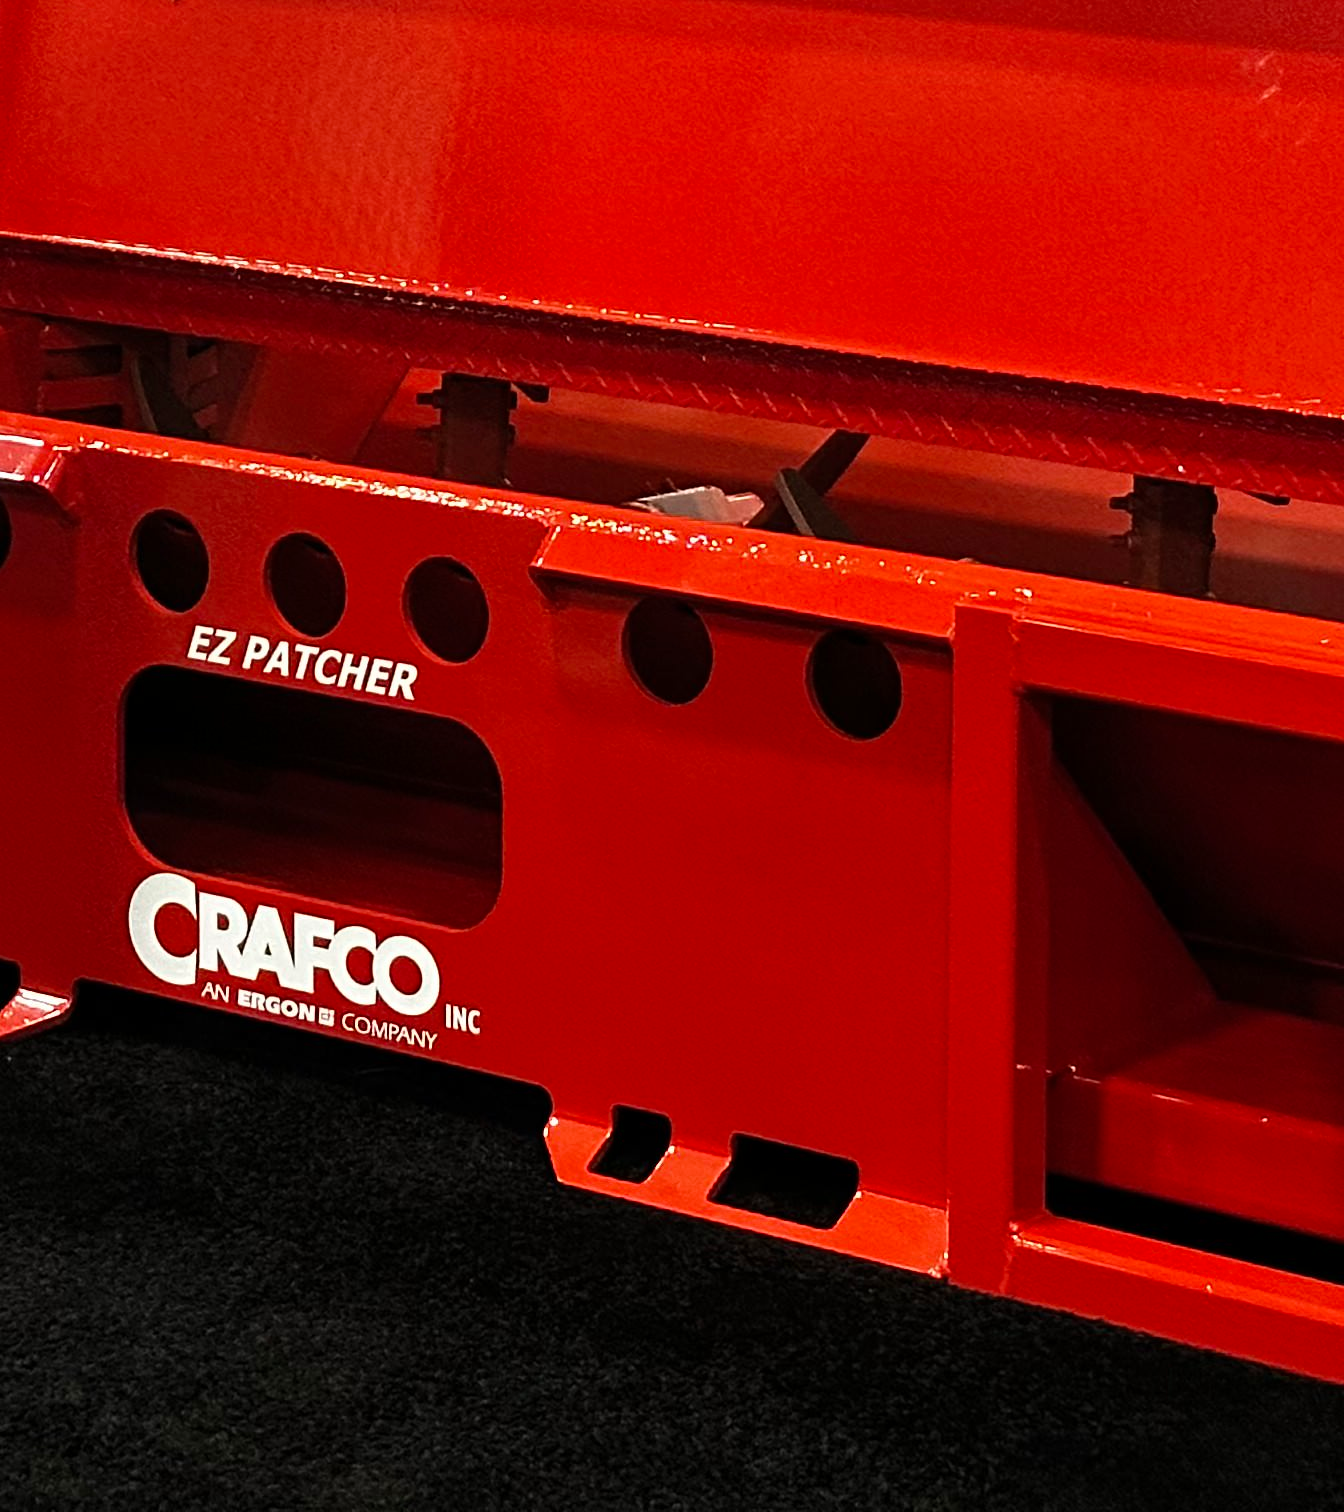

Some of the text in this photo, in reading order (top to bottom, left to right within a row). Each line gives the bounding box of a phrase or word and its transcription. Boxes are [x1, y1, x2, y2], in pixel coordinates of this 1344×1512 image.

[186, 625, 419, 701] EZ PATCHER
[128, 872, 482, 1035] CRAFCO INC
[201, 981, 438, 1051] AN ERGON COMPANY
